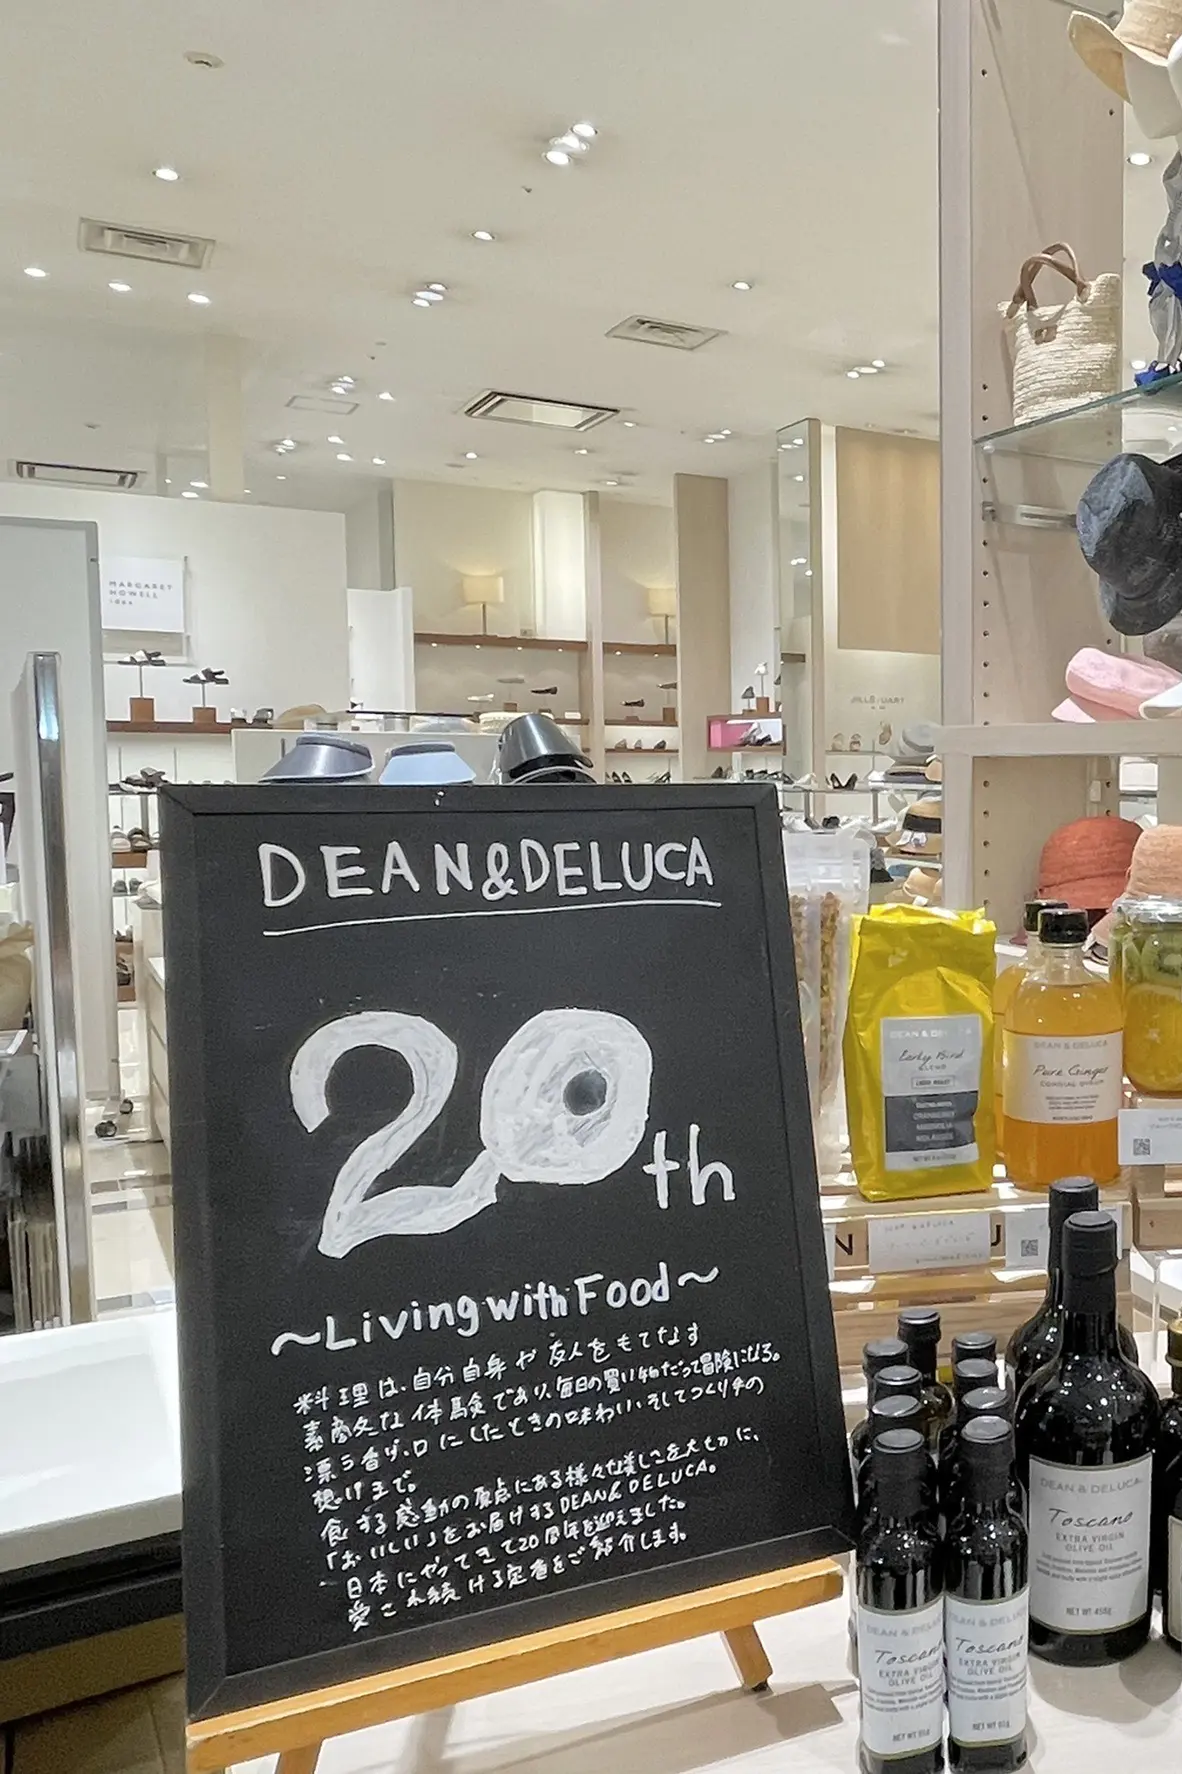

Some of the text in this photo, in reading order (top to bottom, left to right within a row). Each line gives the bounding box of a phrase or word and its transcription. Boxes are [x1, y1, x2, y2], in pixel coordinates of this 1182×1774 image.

[109, 581, 172, 591] MARGARET
[109, 589, 158, 599] HOWELL
[1033, 1064, 1063, 1077] Pure
[485, 1283, 568, 1323] with
[1040, 1477, 1144, 1494] DEAN & DELUCA
[1048, 1507, 1134, 1528] Toscano
[1056, 1531, 1125, 1543] EXTRA VIRGIN
[1065, 1543, 1113, 1553] OLIVE OIL
[866, 1625, 898, 1637] DEAN
[958, 1657, 988, 1667] EXTRA
[878, 1668, 910, 1679] EXTRA
